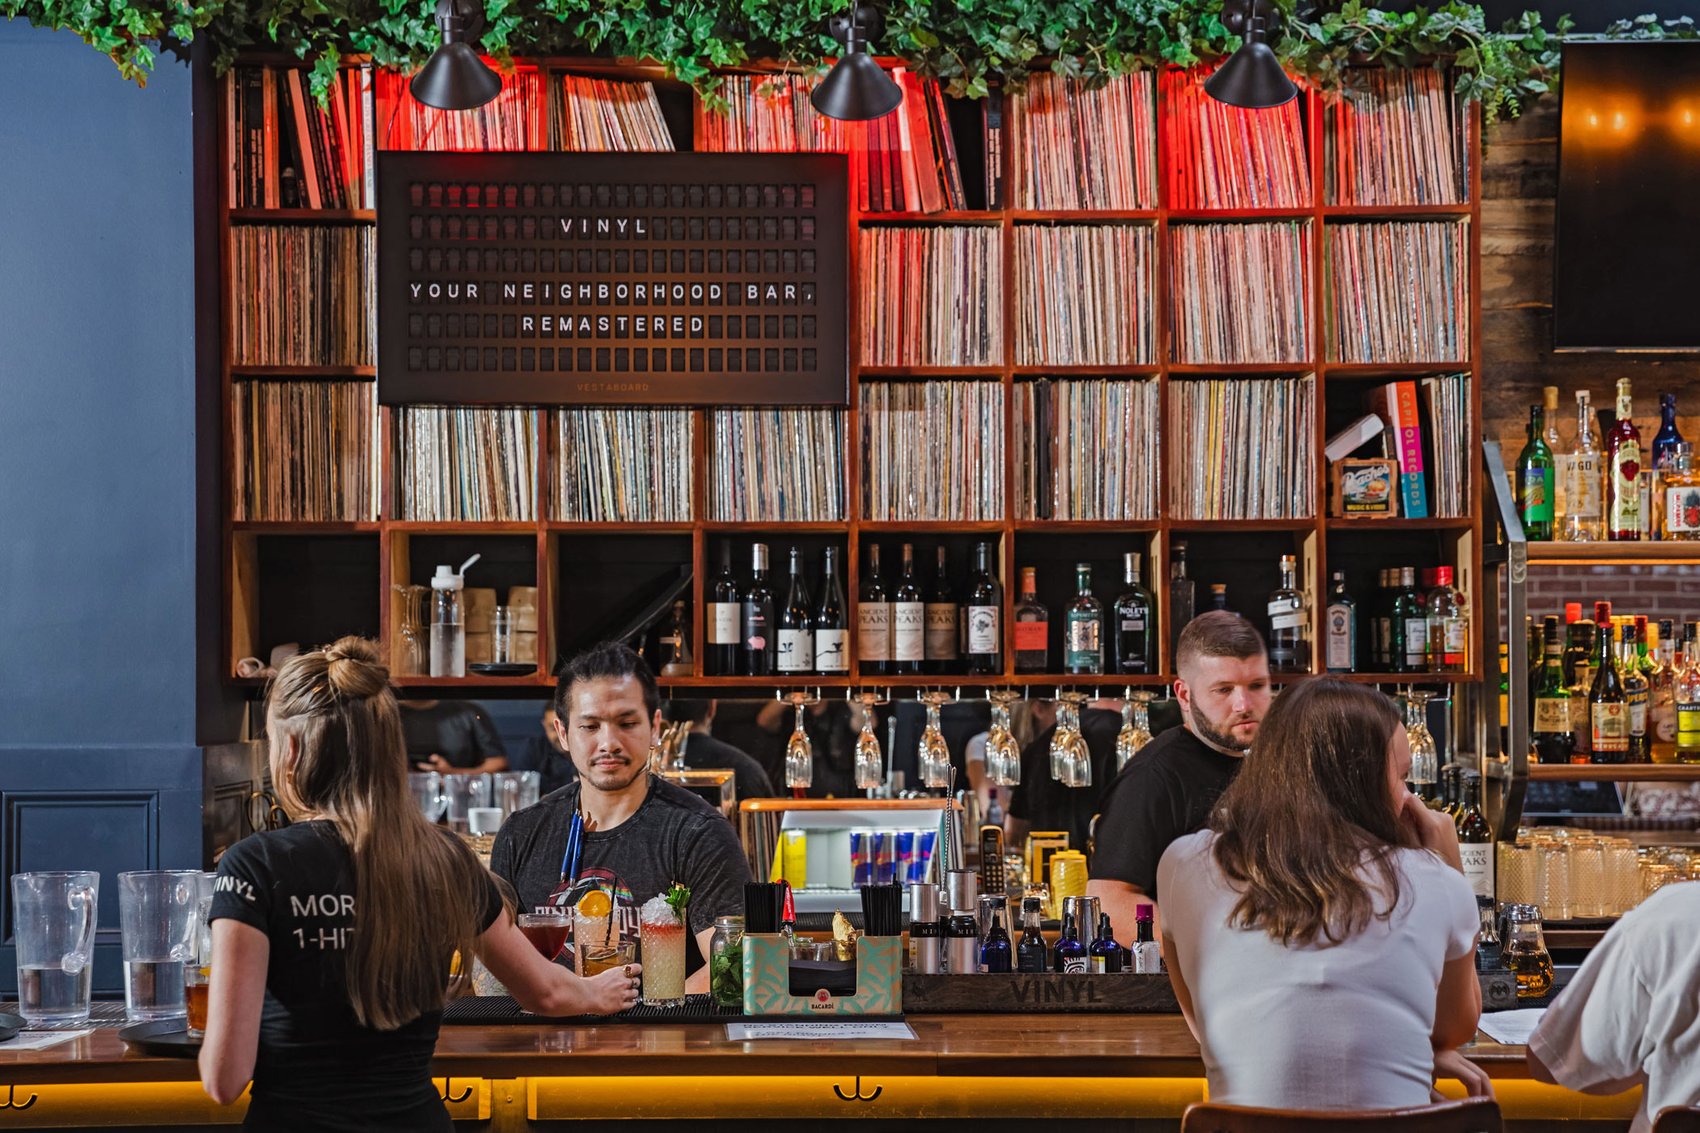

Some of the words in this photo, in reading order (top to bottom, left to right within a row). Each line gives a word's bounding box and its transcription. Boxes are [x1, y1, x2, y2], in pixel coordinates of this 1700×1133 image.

[560, 218, 646, 234] VINYL
[410, 283, 479, 299] YOUR
[504, 283, 722, 299] NEIGHBORHOOD
[747, 283, 813, 300] BAR,
[522, 316, 703, 332] REMASTERED
[576, 383, 650, 392] VESTABOARD
[1401, 391, 1415, 445] CAPITOL
[1406, 449, 1421, 506] RECORDS
[290, 894, 356, 917] MOR
[1010, 980, 1104, 1004] VINYL
